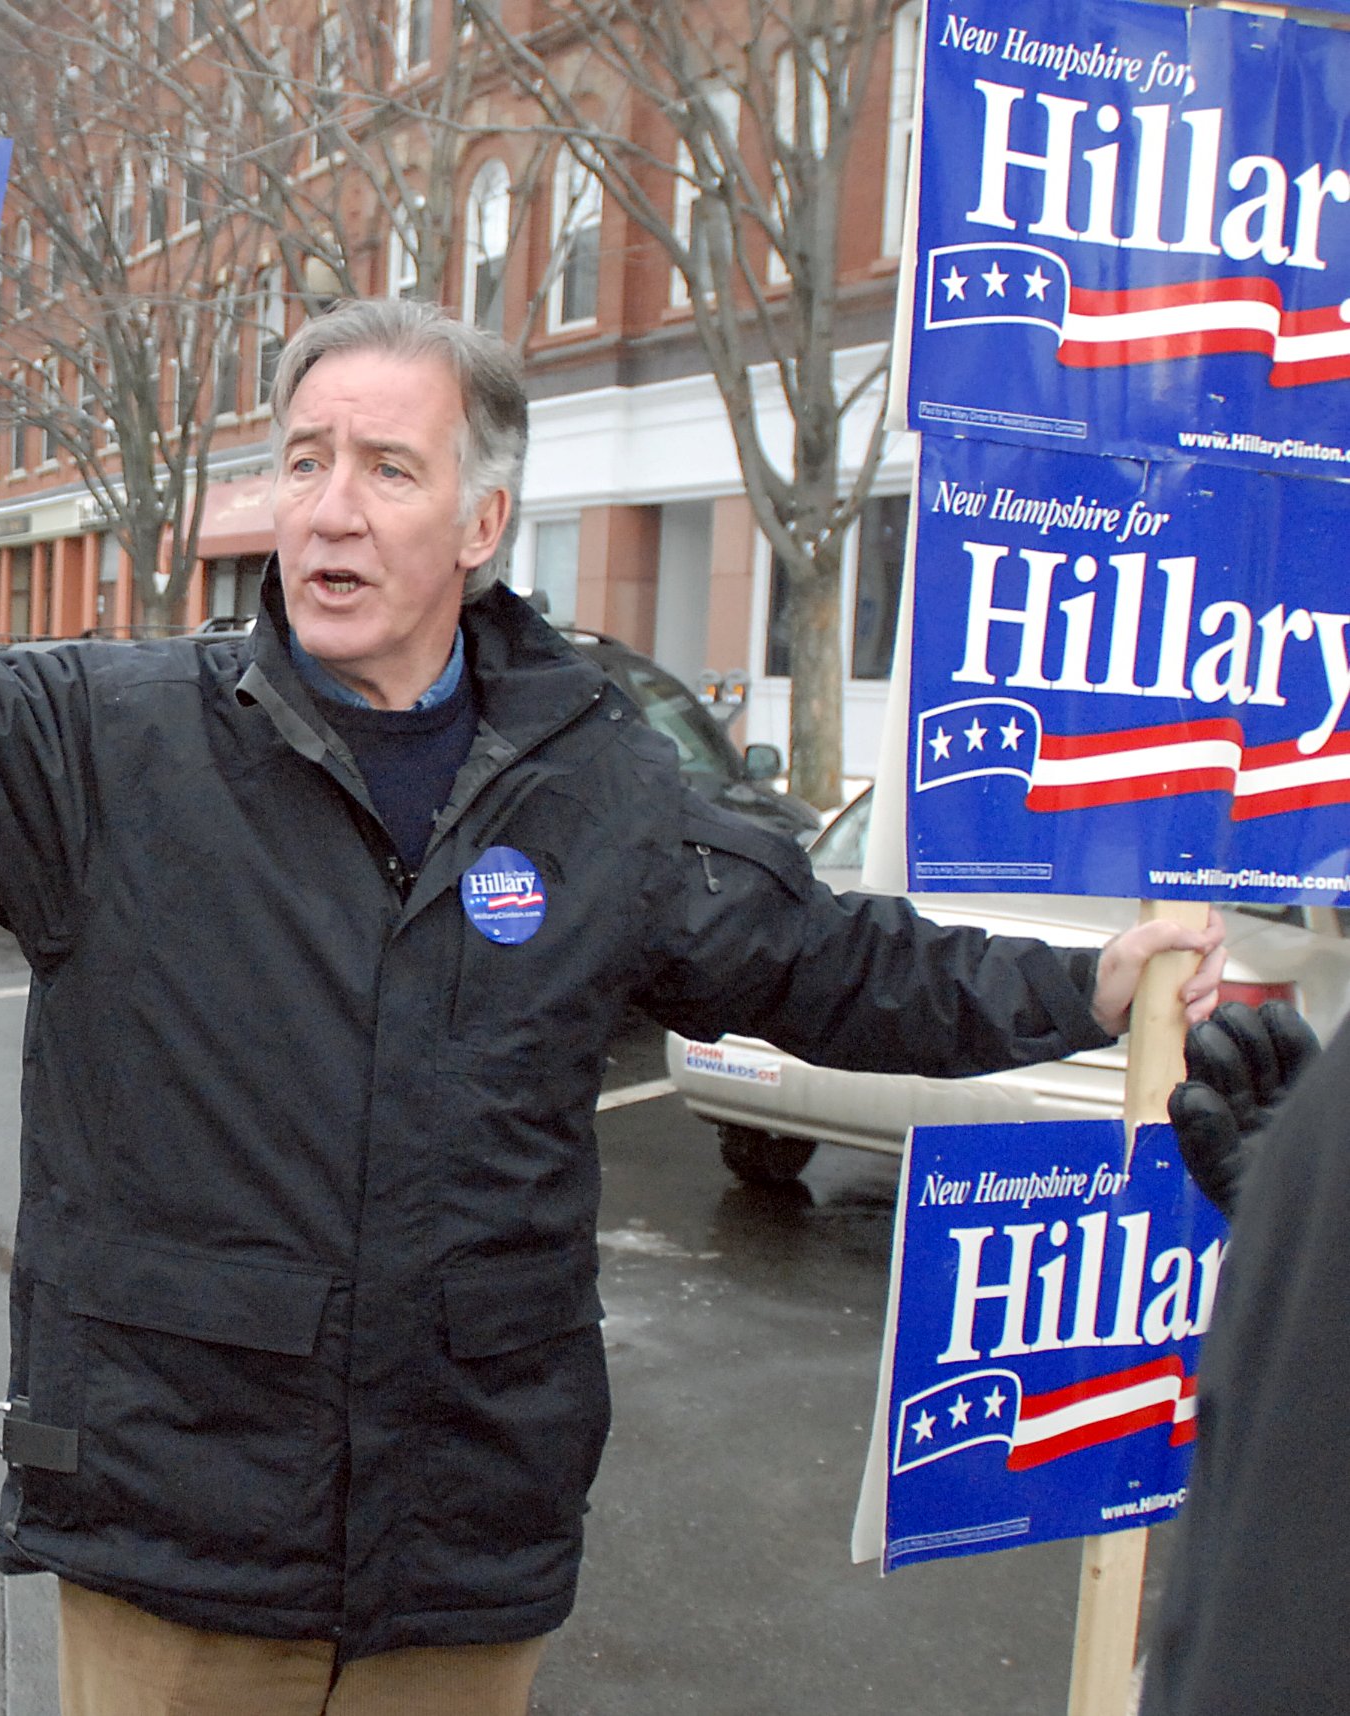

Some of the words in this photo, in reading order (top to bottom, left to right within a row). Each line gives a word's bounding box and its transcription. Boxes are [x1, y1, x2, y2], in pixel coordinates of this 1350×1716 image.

[940, 14, 998, 55] New
[1001, 28, 1141, 81] Hampshire
[1139, 50, 1191, 93] for
[966, 78, 1350, 323] Hillar
[932, 480, 986, 517] New
[989, 487, 1120, 535] Hampshire
[1117, 500, 1171, 542] for
[951, 540, 1350, 756] Hillary
[469, 872, 535, 897] Hillary
[687, 1044, 723, 1060] JOHN
[919, 1173, 970, 1207] New
[973, 1166, 1087, 1210] Hampshire
[1083, 1162, 1130, 1204] for
[936, 1211, 1230, 1364] Hillar
